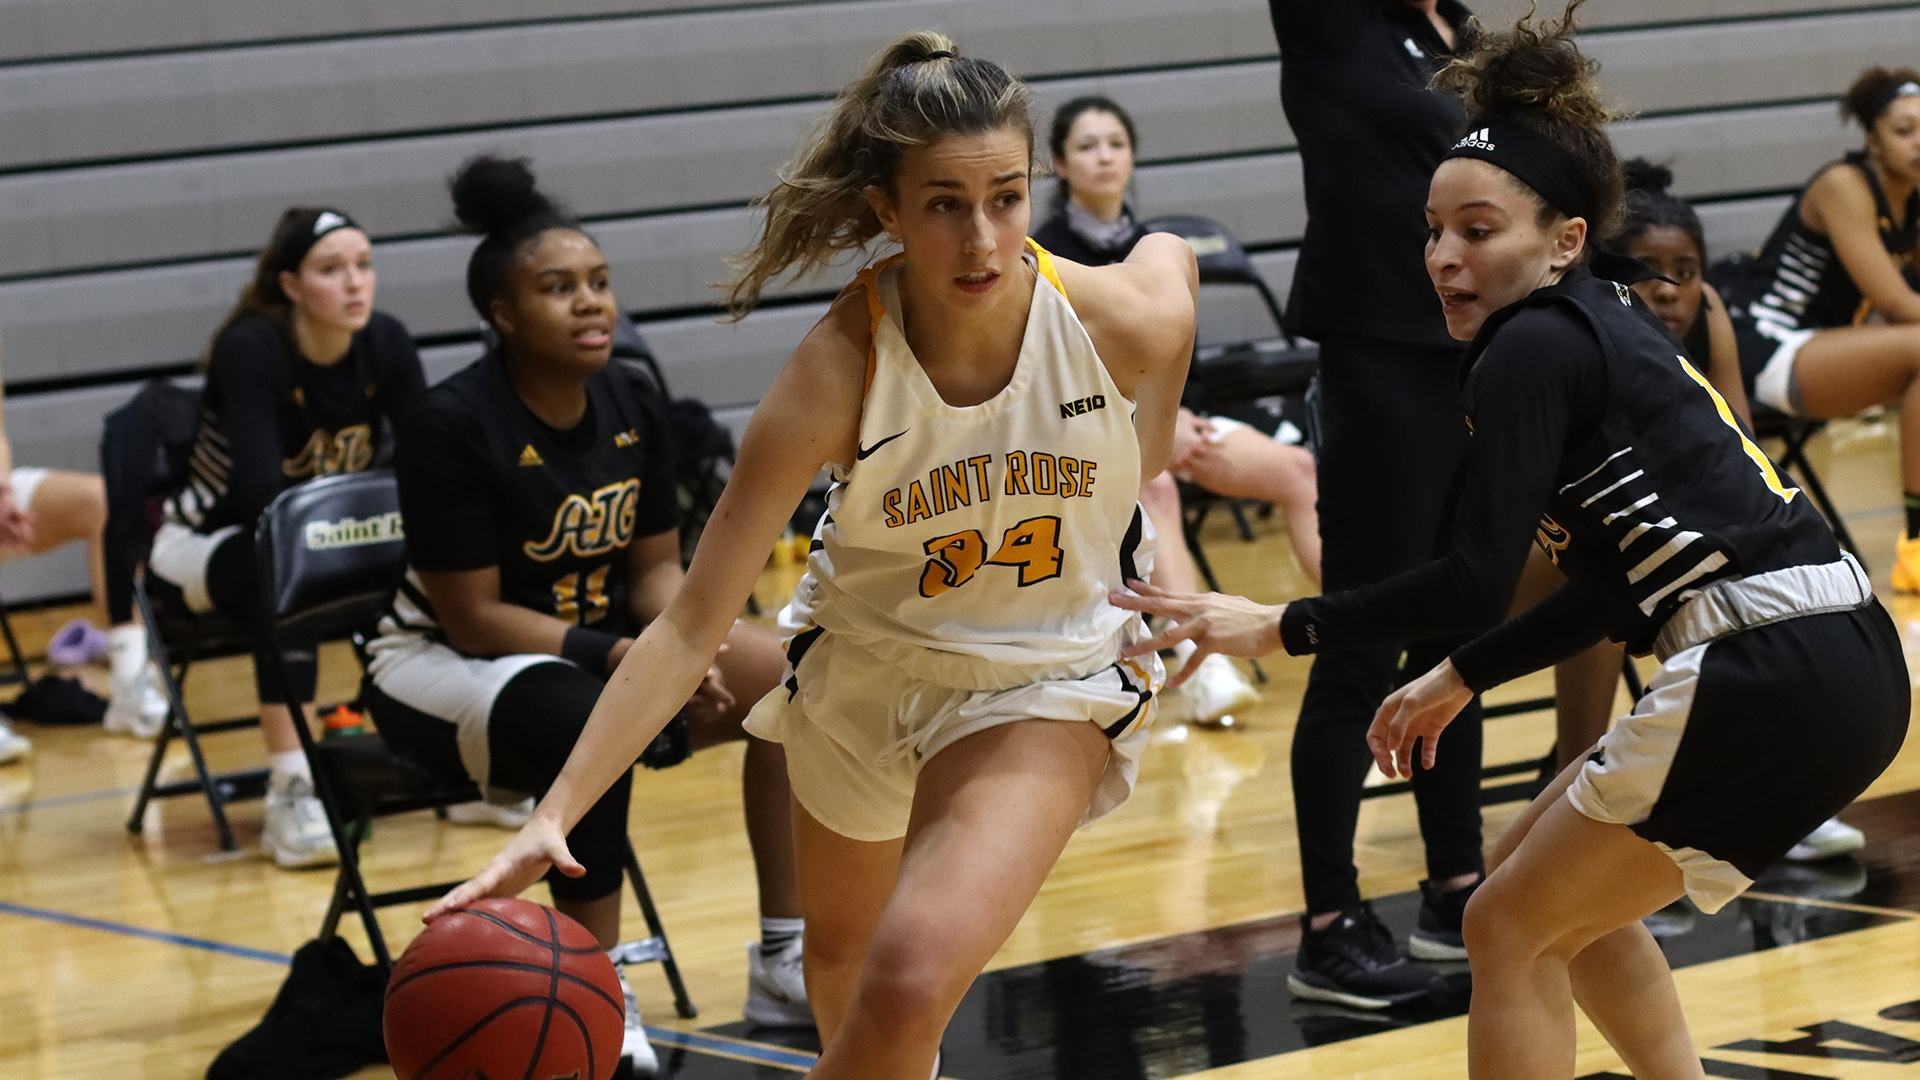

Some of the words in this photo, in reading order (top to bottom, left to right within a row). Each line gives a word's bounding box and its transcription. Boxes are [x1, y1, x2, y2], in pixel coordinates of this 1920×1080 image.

[1059, 394, 1106, 419] NE10
[883, 454, 992, 528] SAINT
[1004, 450, 1097, 498] ROSE
[918, 515, 1064, 598] 34
